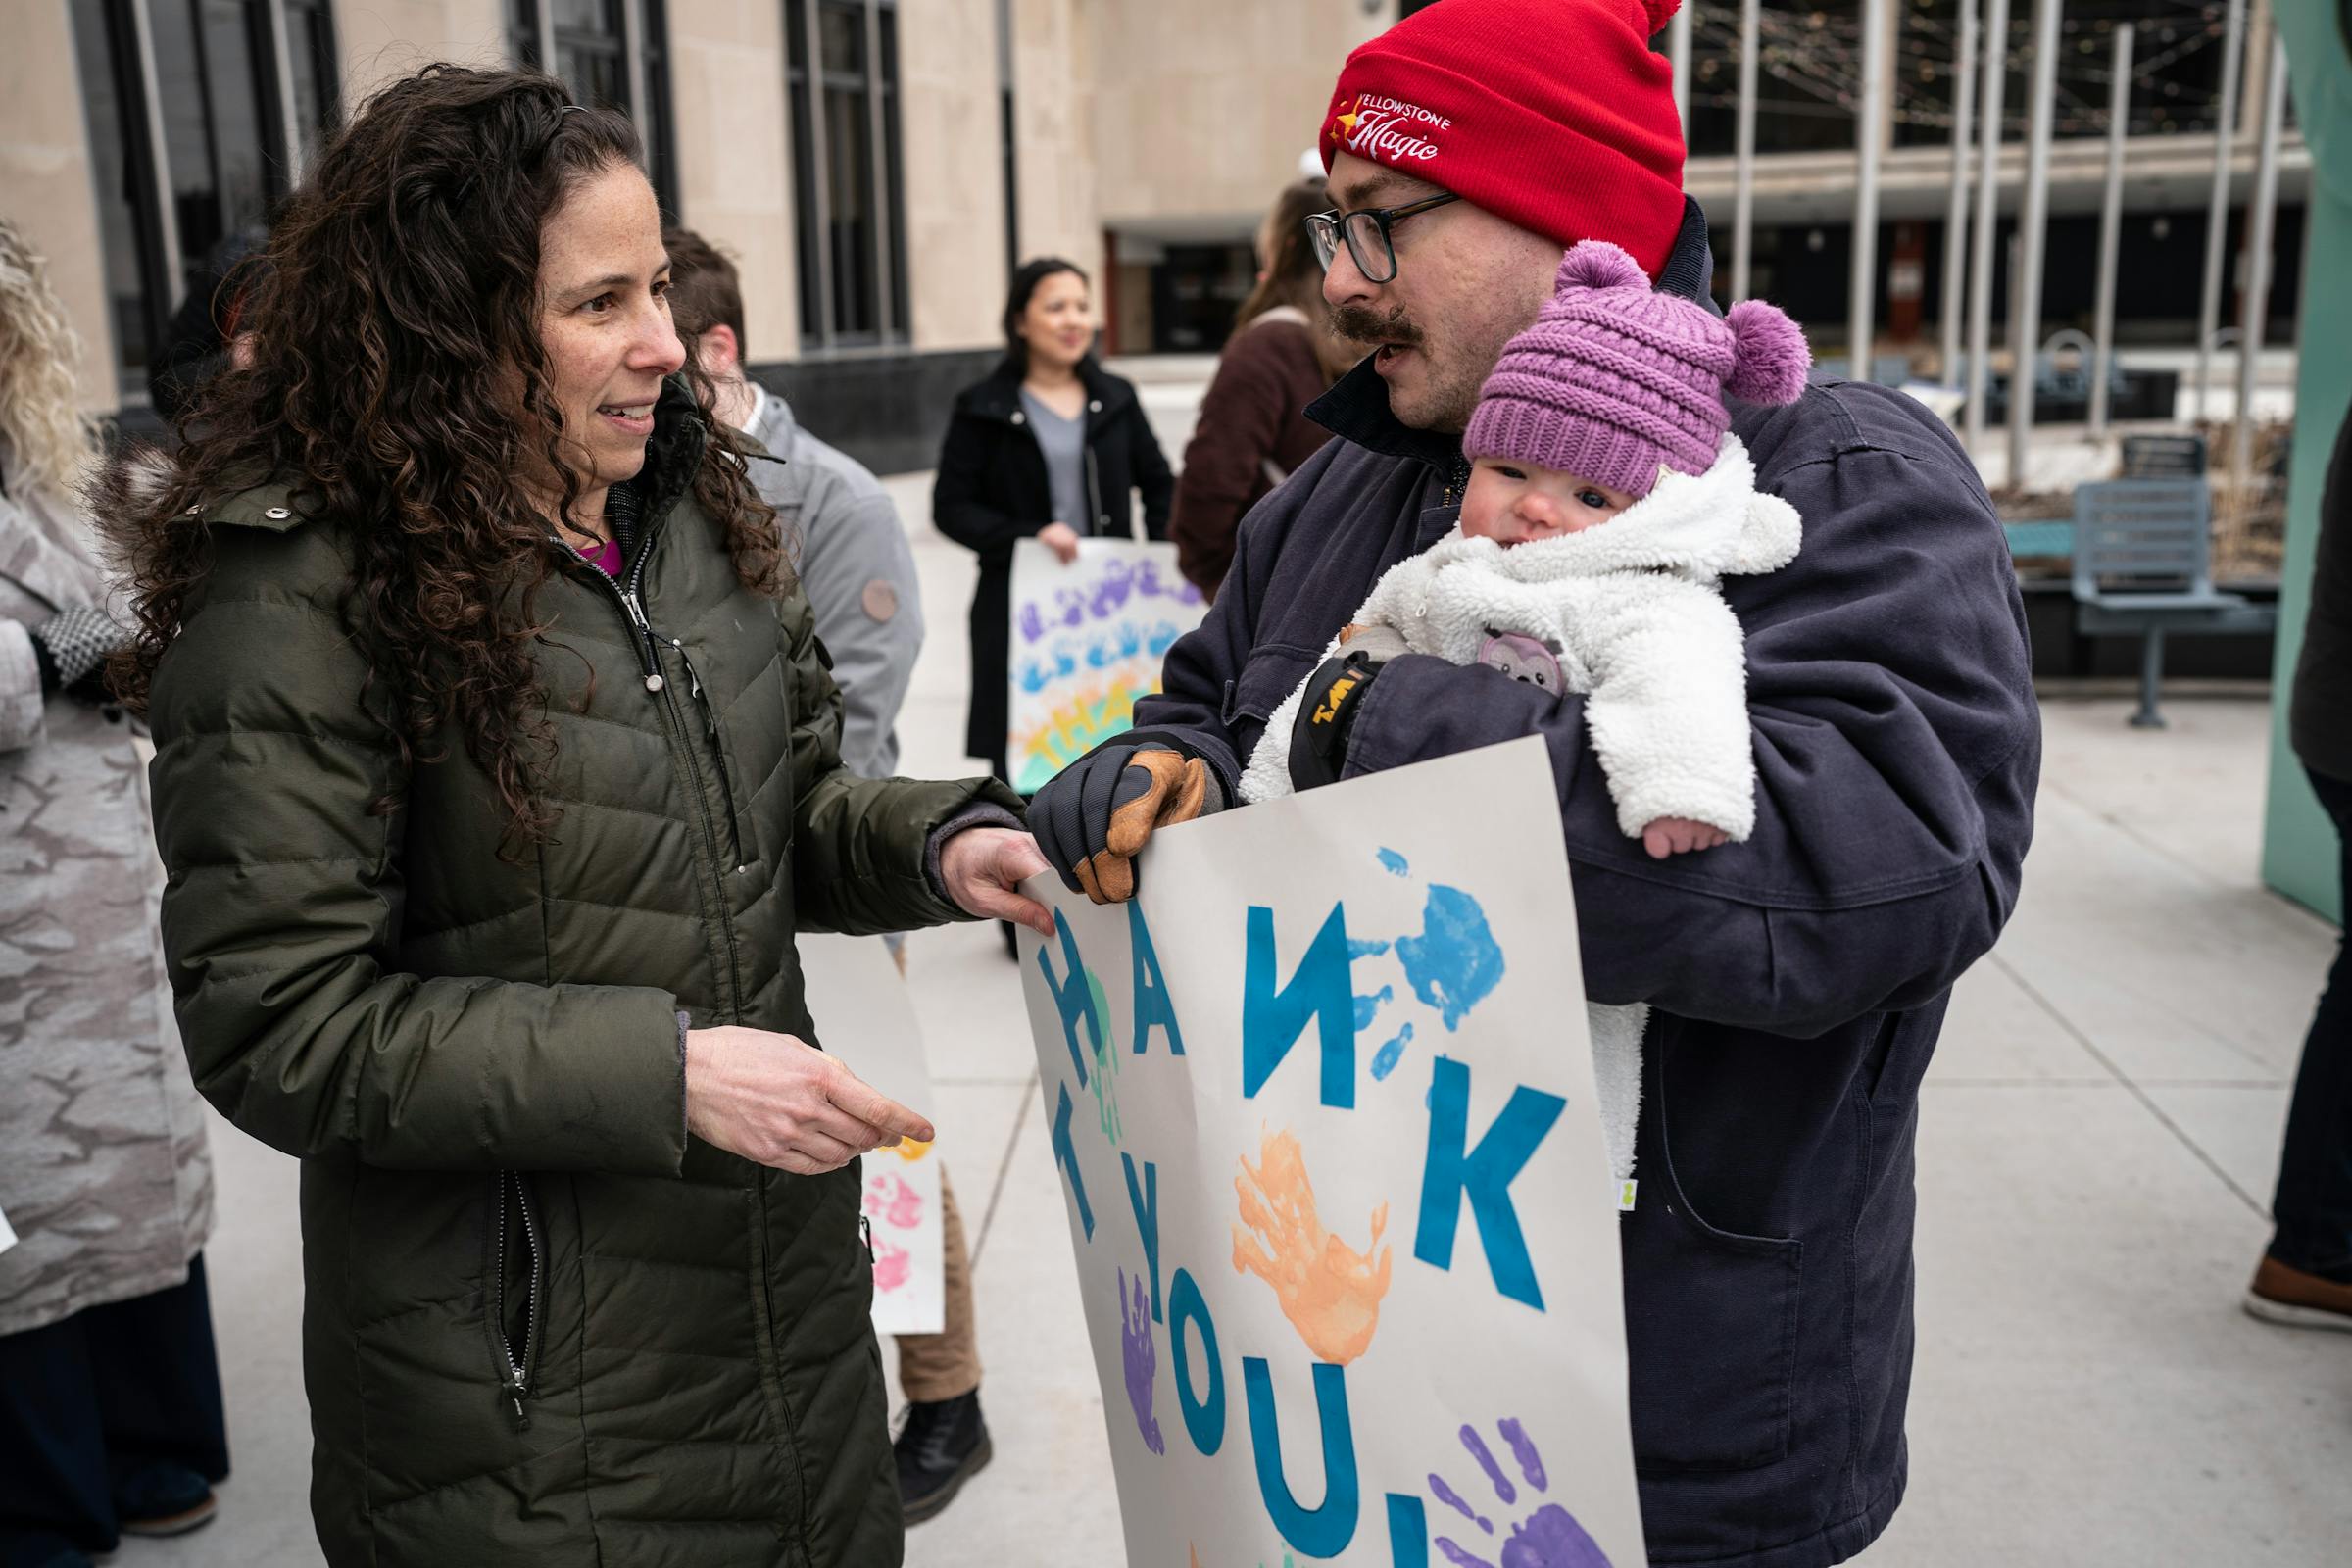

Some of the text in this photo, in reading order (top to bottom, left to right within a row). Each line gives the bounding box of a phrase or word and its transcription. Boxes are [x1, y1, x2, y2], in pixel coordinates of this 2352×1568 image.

[1348, 110, 1438, 161] Magic
[1360, 94, 1451, 130] YELLOWSTONE
[1037, 899, 1568, 1313] THANK
